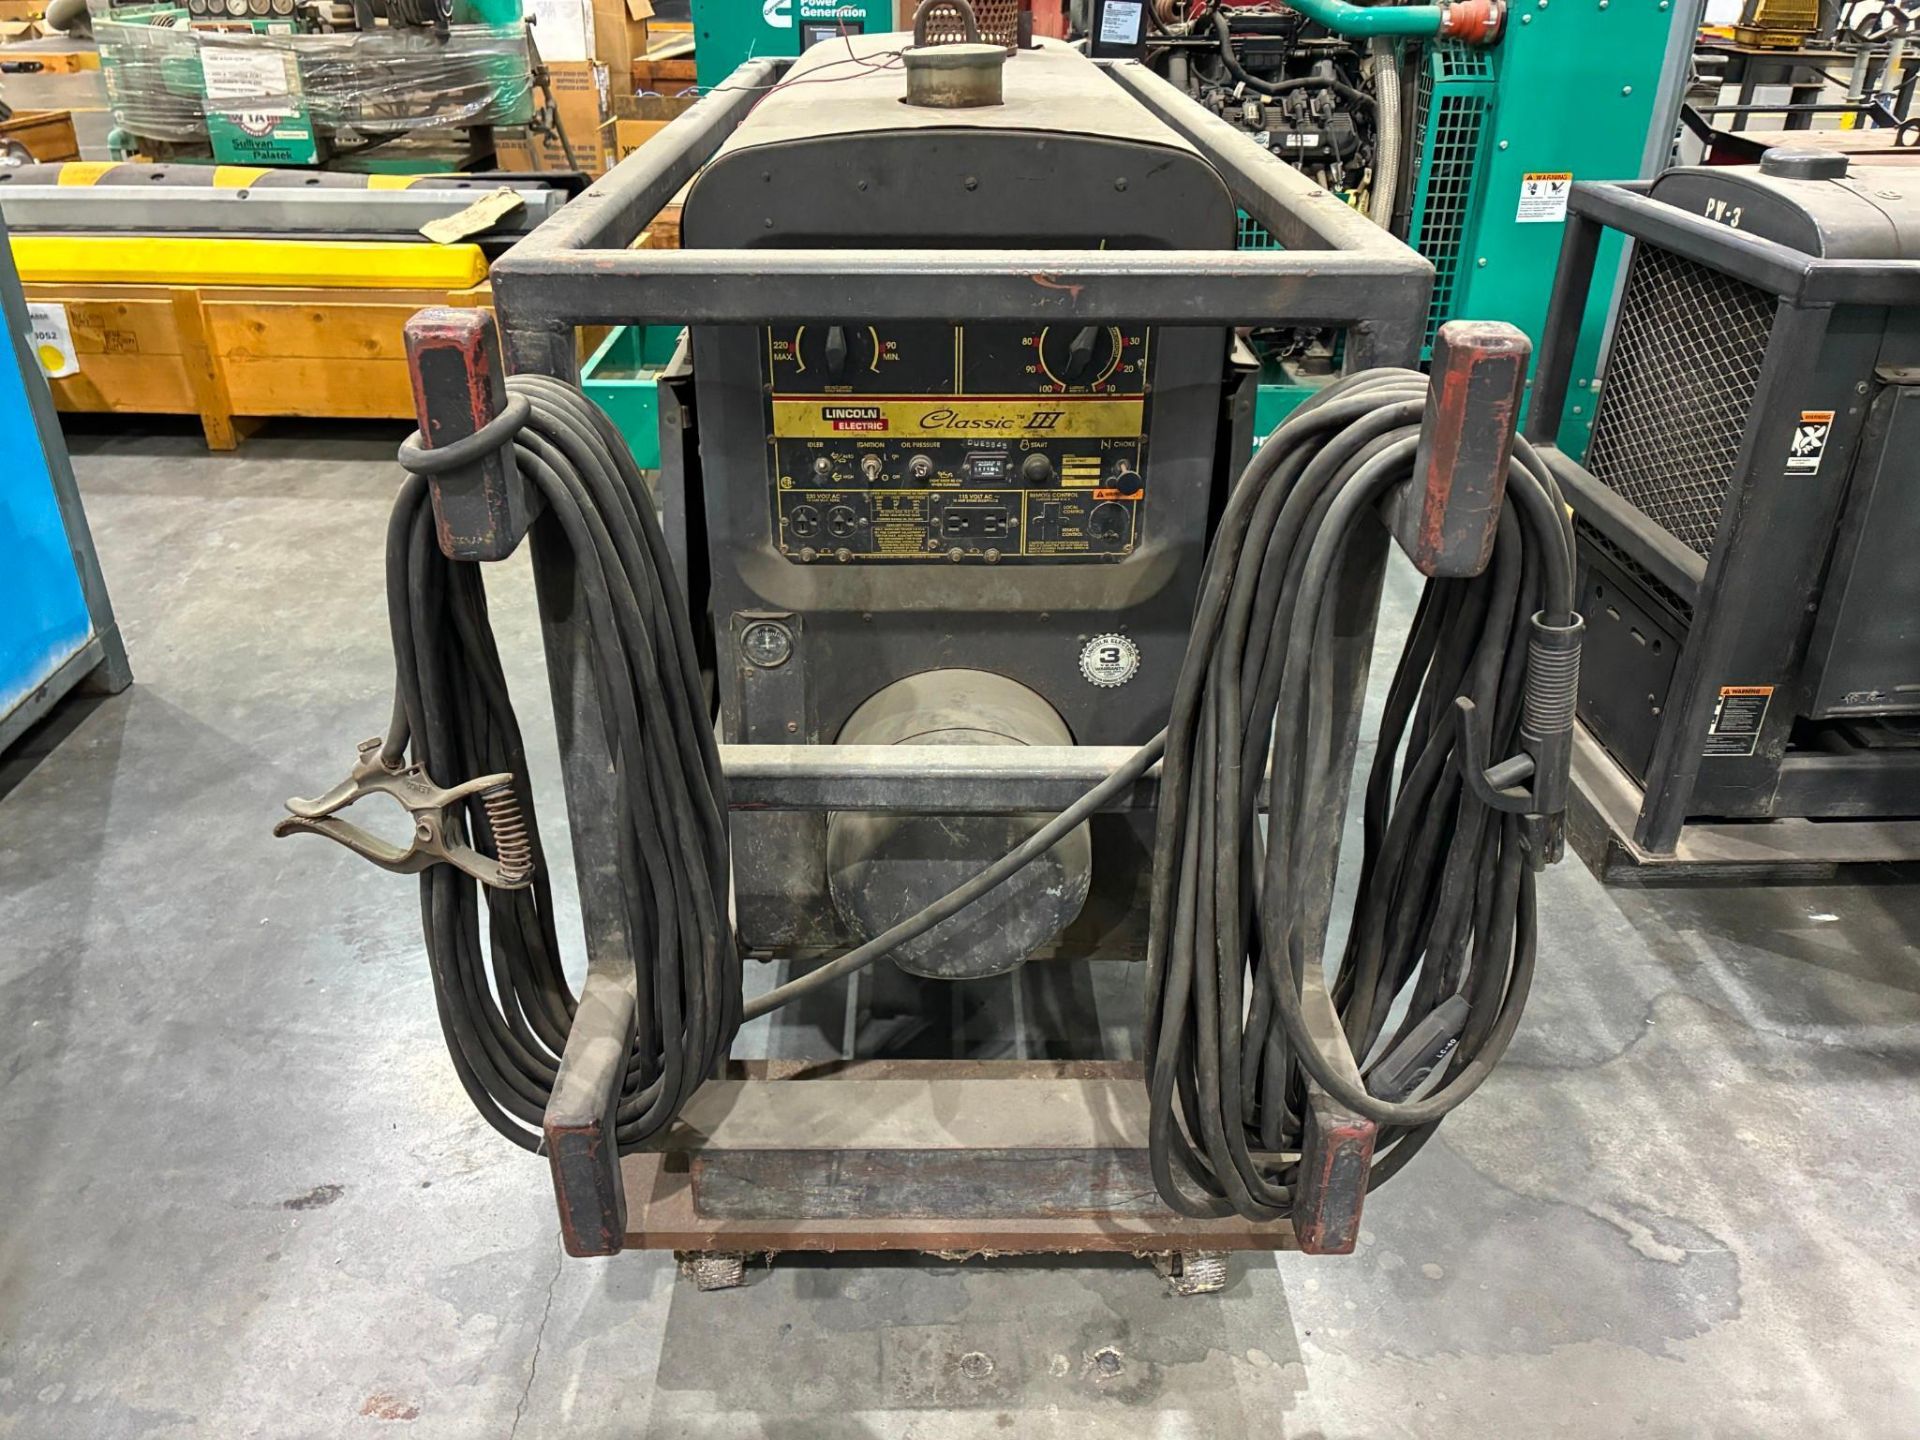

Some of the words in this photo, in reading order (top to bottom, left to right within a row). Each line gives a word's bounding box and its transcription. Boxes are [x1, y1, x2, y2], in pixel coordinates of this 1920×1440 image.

[1705, 198, 1742, 227] PW-3
[886, 341, 896, 350] 90
[1130, 337, 1140, 345] 30
[1124, 365, 1134, 373] 20
[826, 409, 878, 418] LINCOLN
[920, 409, 1014, 429] Classic
[1024, 412, 1065, 429] III
[838, 422, 884, 430] ELECTRIC
[1086, 639, 1109, 658] LINCOLN
[1110, 639, 1134, 657] ELECTRIC
[1100, 647, 1120, 664] 3
